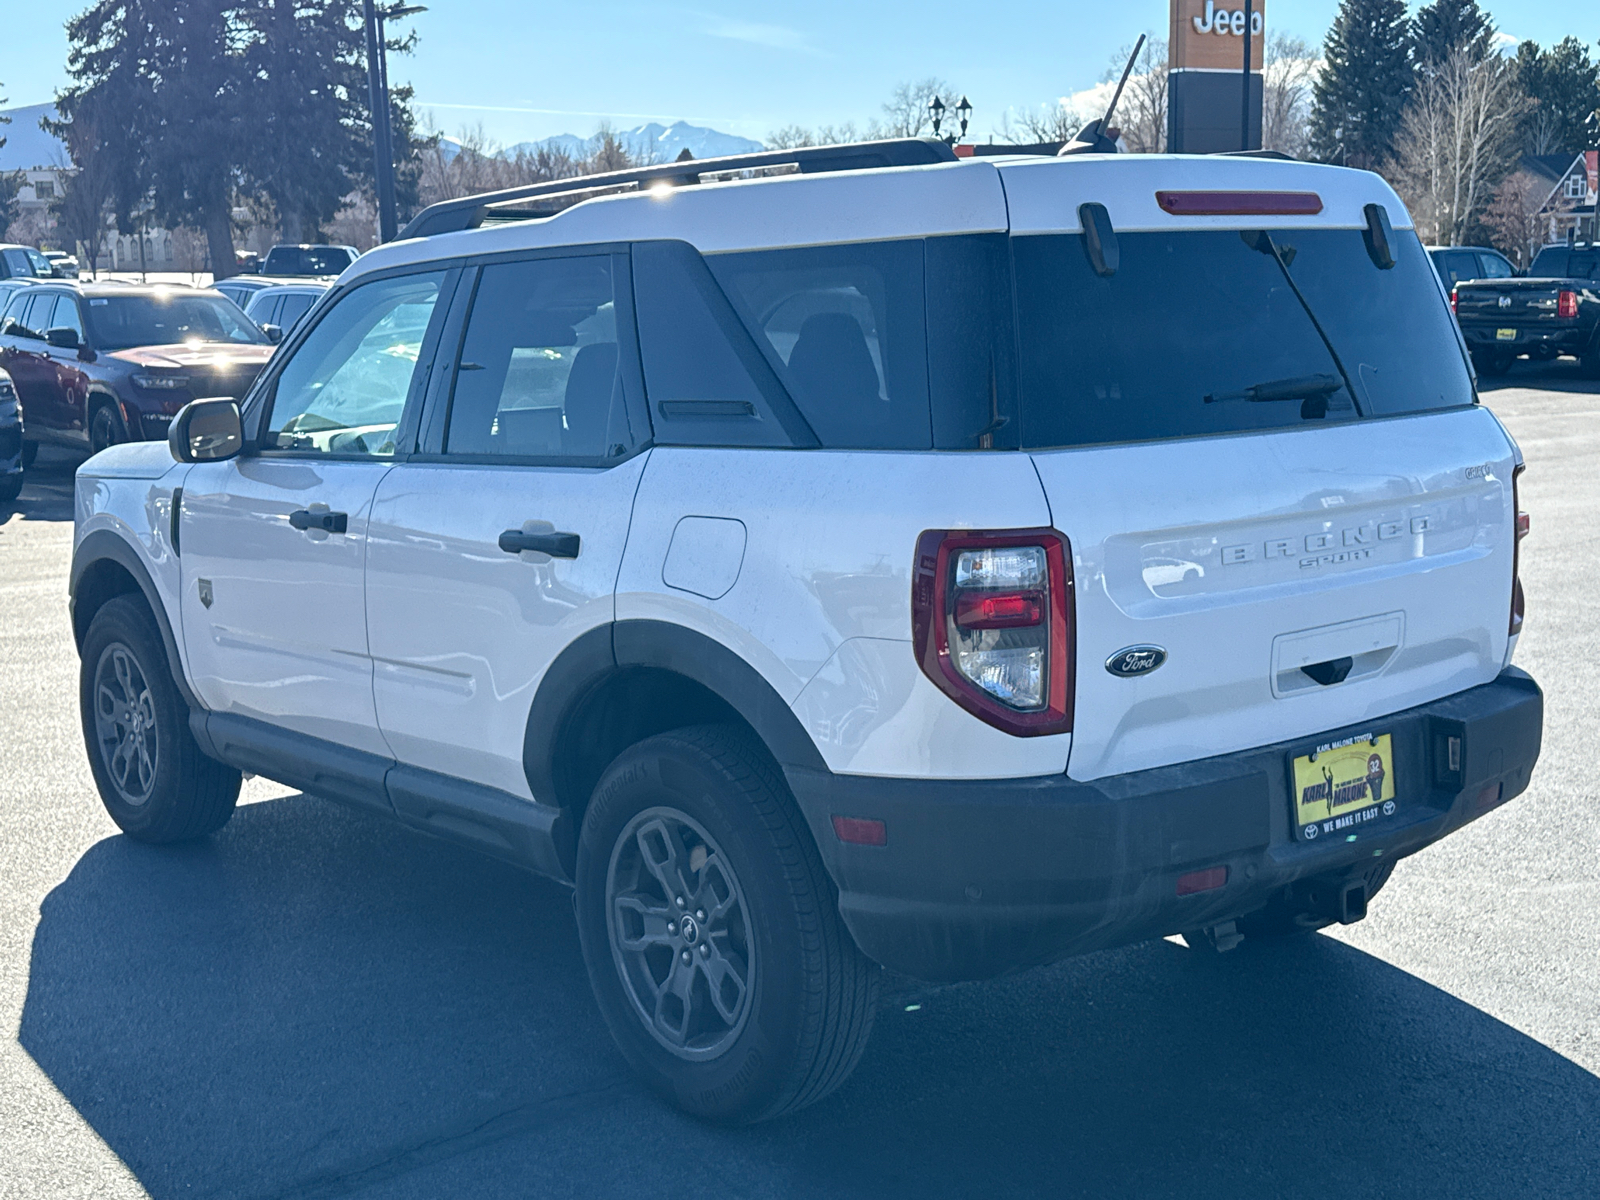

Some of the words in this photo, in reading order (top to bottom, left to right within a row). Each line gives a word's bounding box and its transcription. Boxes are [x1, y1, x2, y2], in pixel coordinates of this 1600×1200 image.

[1193, 0, 1263, 36] Jeep
[1220, 514, 1433, 566] BRONCO
[1299, 547, 1376, 569] SPORT
[1121, 652, 1156, 672] Ford
[1316, 742, 1332, 754] KARL
[1331, 737, 1354, 750] MALONE
[1354, 732, 1373, 744] TOYOTA
[1369, 759, 1380, 773] 32
[1301, 781, 1328, 806] KARL
[1332, 781, 1369, 808] MALONE
[1323, 821, 1334, 833] WE
[1335, 814, 1354, 830] MAKE
[1354, 812, 1361, 824] IT
[1362, 807, 1378, 822] EASY
